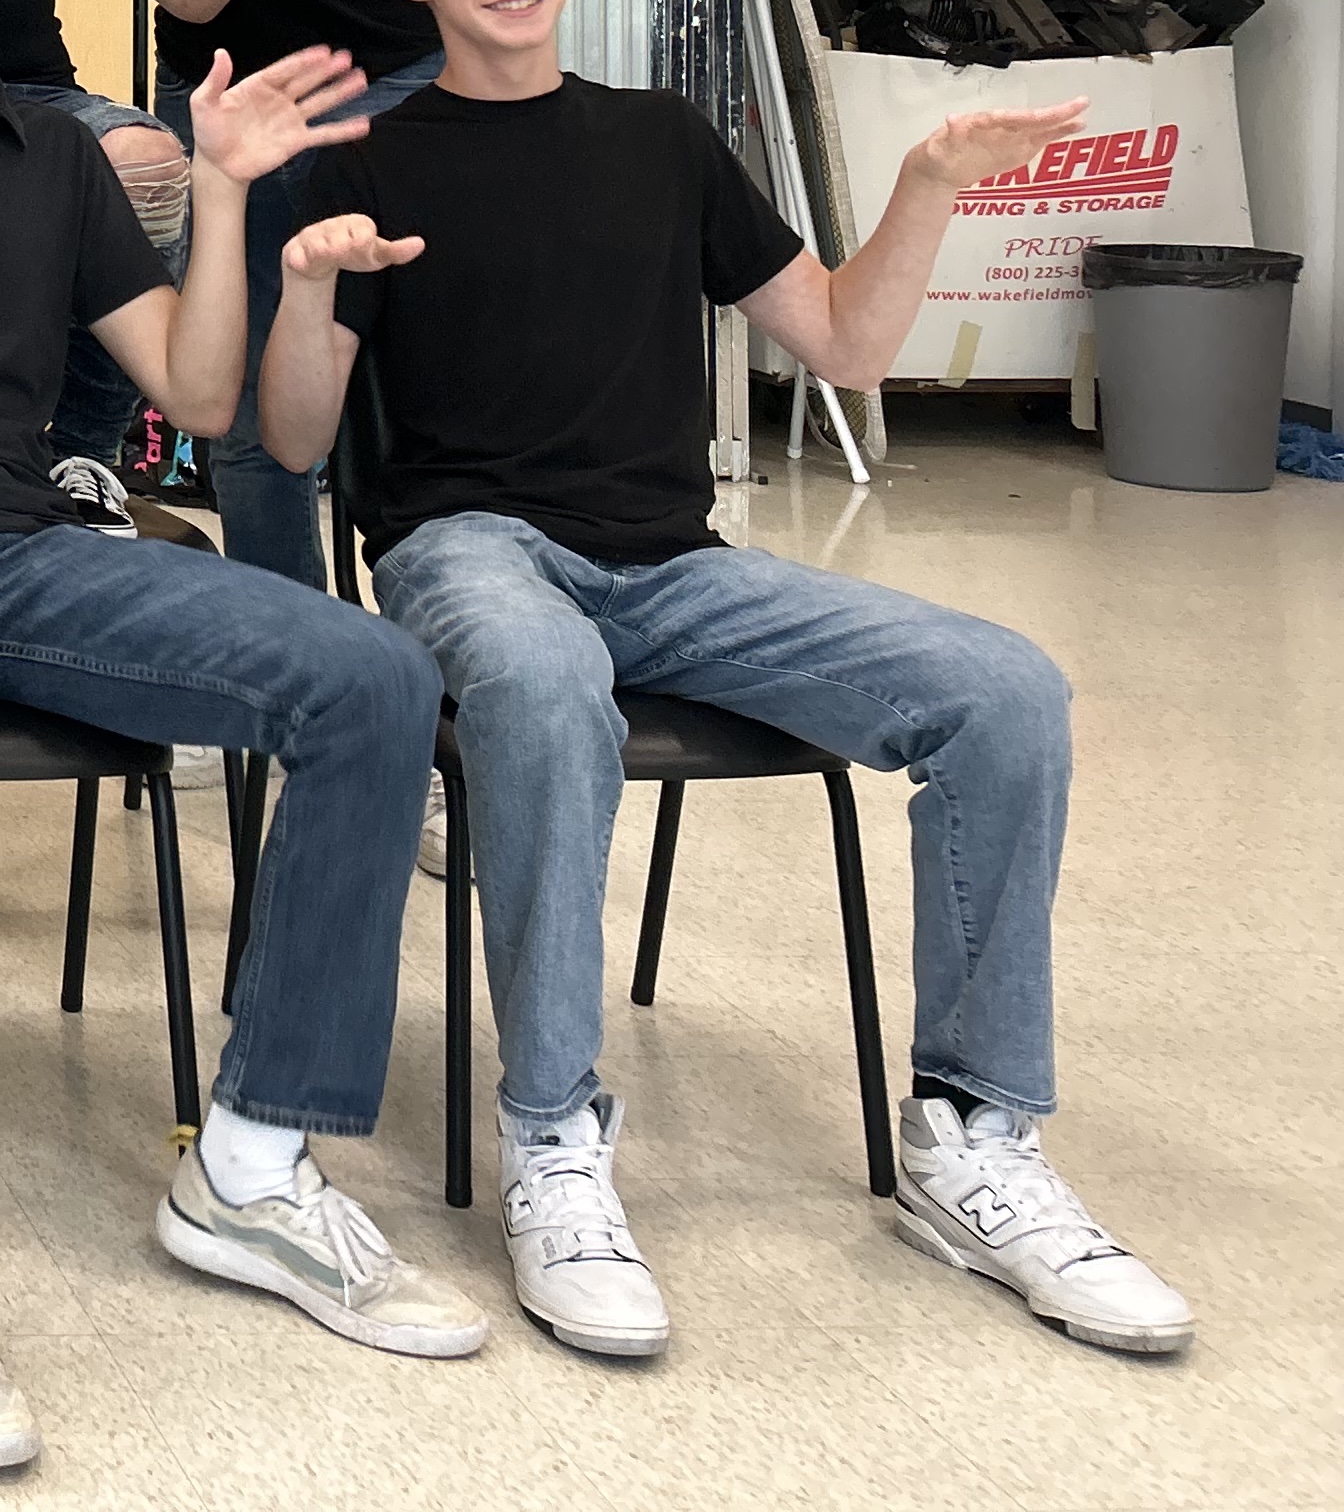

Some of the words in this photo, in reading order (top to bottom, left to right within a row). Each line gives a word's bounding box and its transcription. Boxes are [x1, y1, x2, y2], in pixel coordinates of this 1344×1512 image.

[972, 124, 1179, 188] EFIELD
[952, 202, 1025, 216] VING
[1033, 201, 1049, 215] &
[1057, 195, 1165, 214] STORAGE
[985, 266, 1029, 282] (800)
